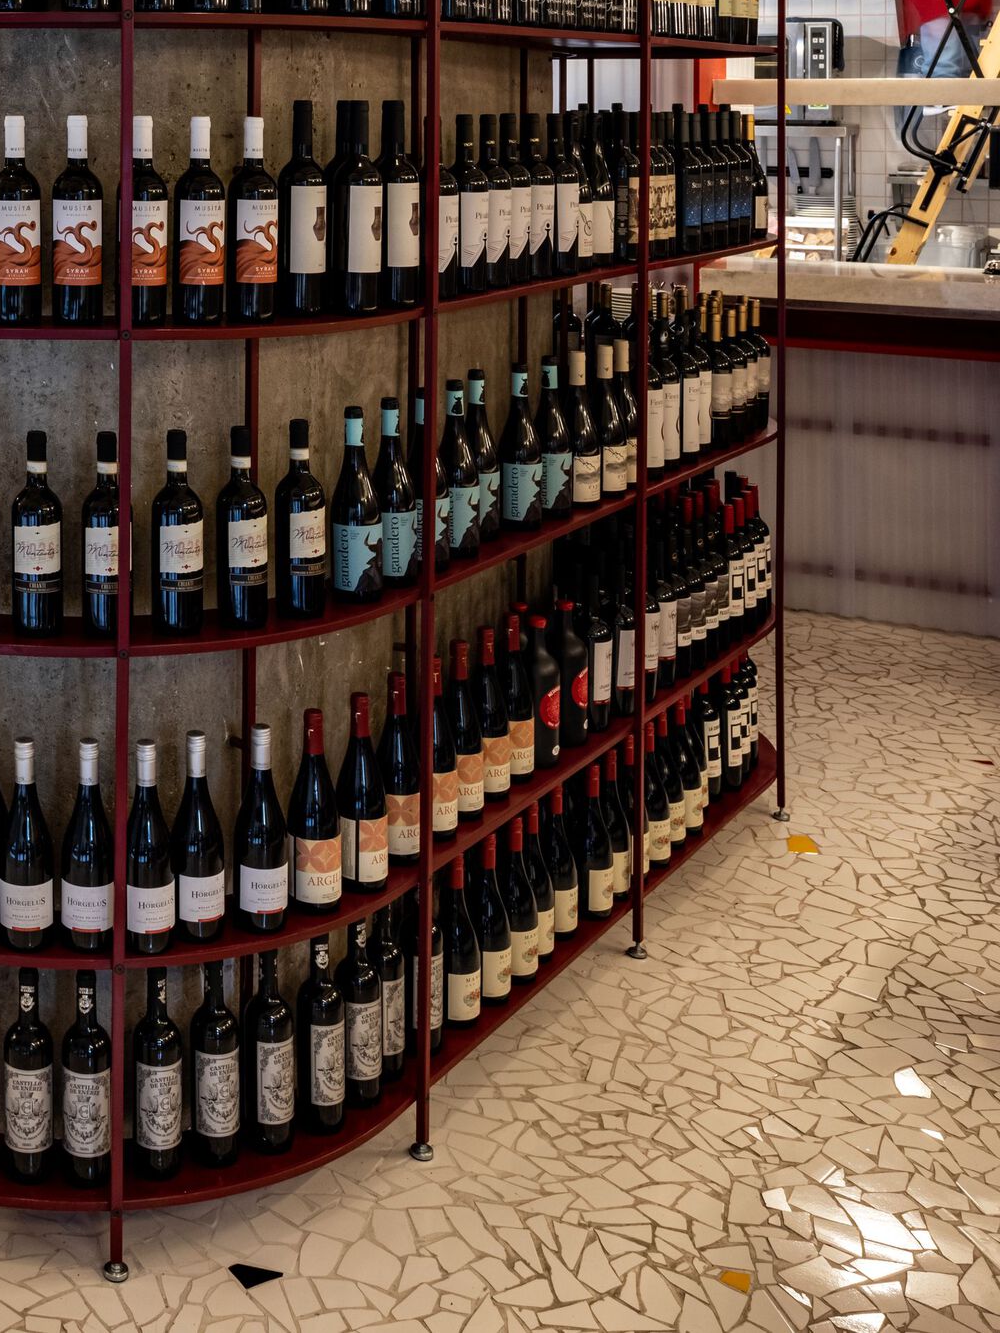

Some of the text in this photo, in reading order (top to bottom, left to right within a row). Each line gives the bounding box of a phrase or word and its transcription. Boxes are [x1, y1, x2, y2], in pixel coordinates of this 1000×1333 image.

[387, 516, 403, 575] ganadero
[336, 528, 353, 588] ganadero
[6, 895, 46, 907] HORGELUS
[67, 896, 107, 908] HORGELUS
[12, 1079, 43, 1087] CASTILLO
[69, 1083, 100, 1091] CASTILLO
